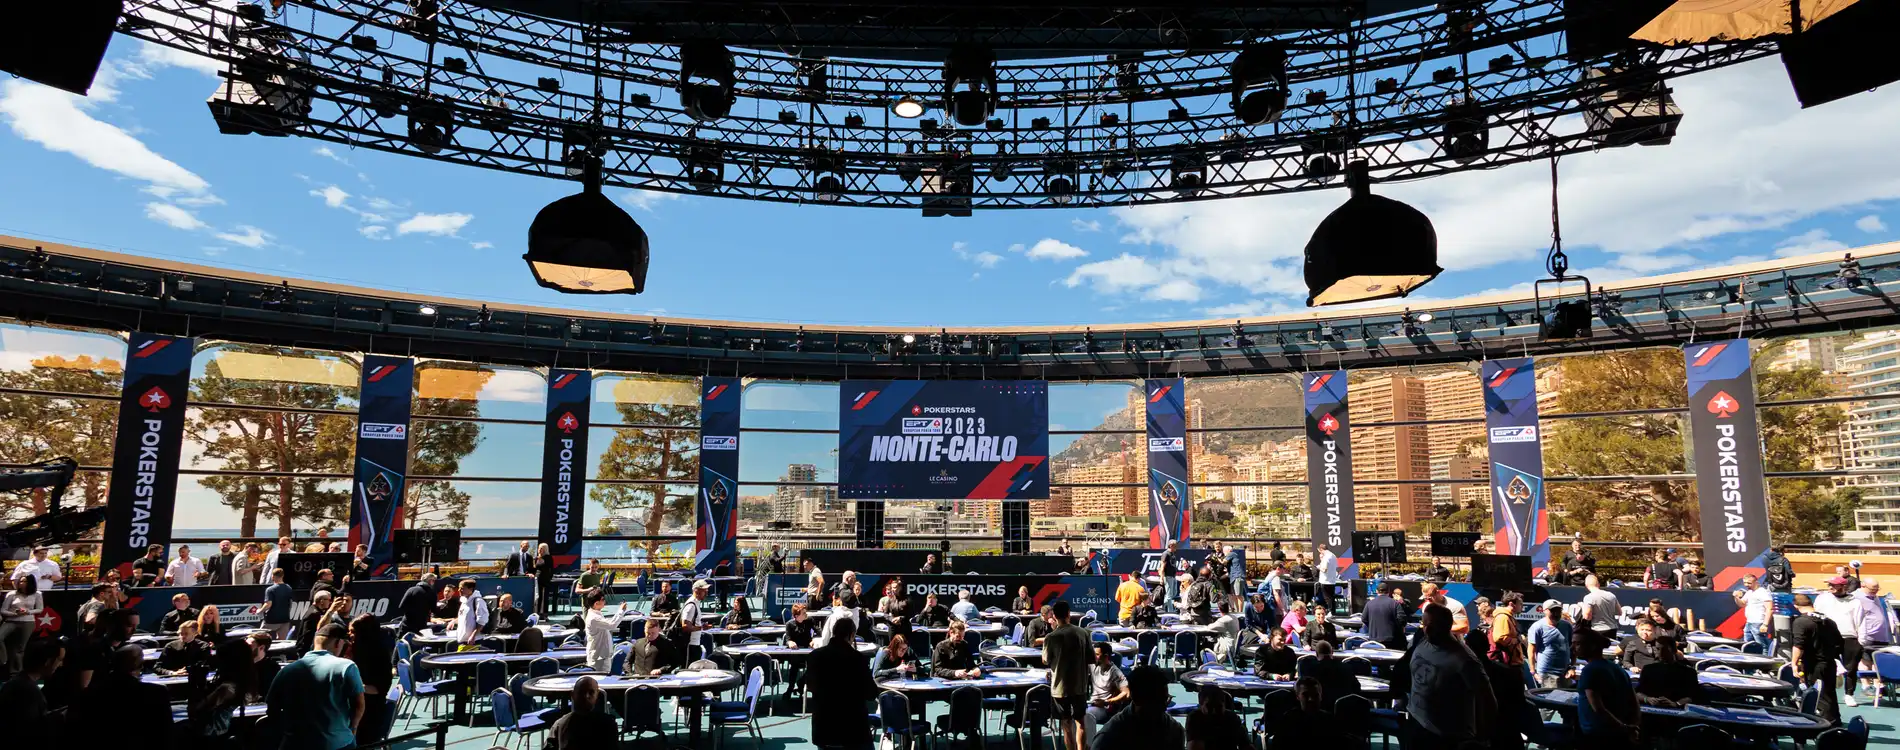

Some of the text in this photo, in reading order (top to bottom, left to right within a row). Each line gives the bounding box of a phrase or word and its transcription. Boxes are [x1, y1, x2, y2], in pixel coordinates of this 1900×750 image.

[869, 435, 1018, 462] MONTE-CARLO
[944, 417, 985, 434] 2023
[129, 419, 162, 548] POKERSTARS
[555, 439, 573, 544] POKERSTARS
[1323, 440, 1342, 547] POKERSTARS
[1715, 424, 1747, 553] POKERSTARS
[1441, 537, 1469, 545] 09:18
[906, 584, 1006, 595] POKERSTARS
